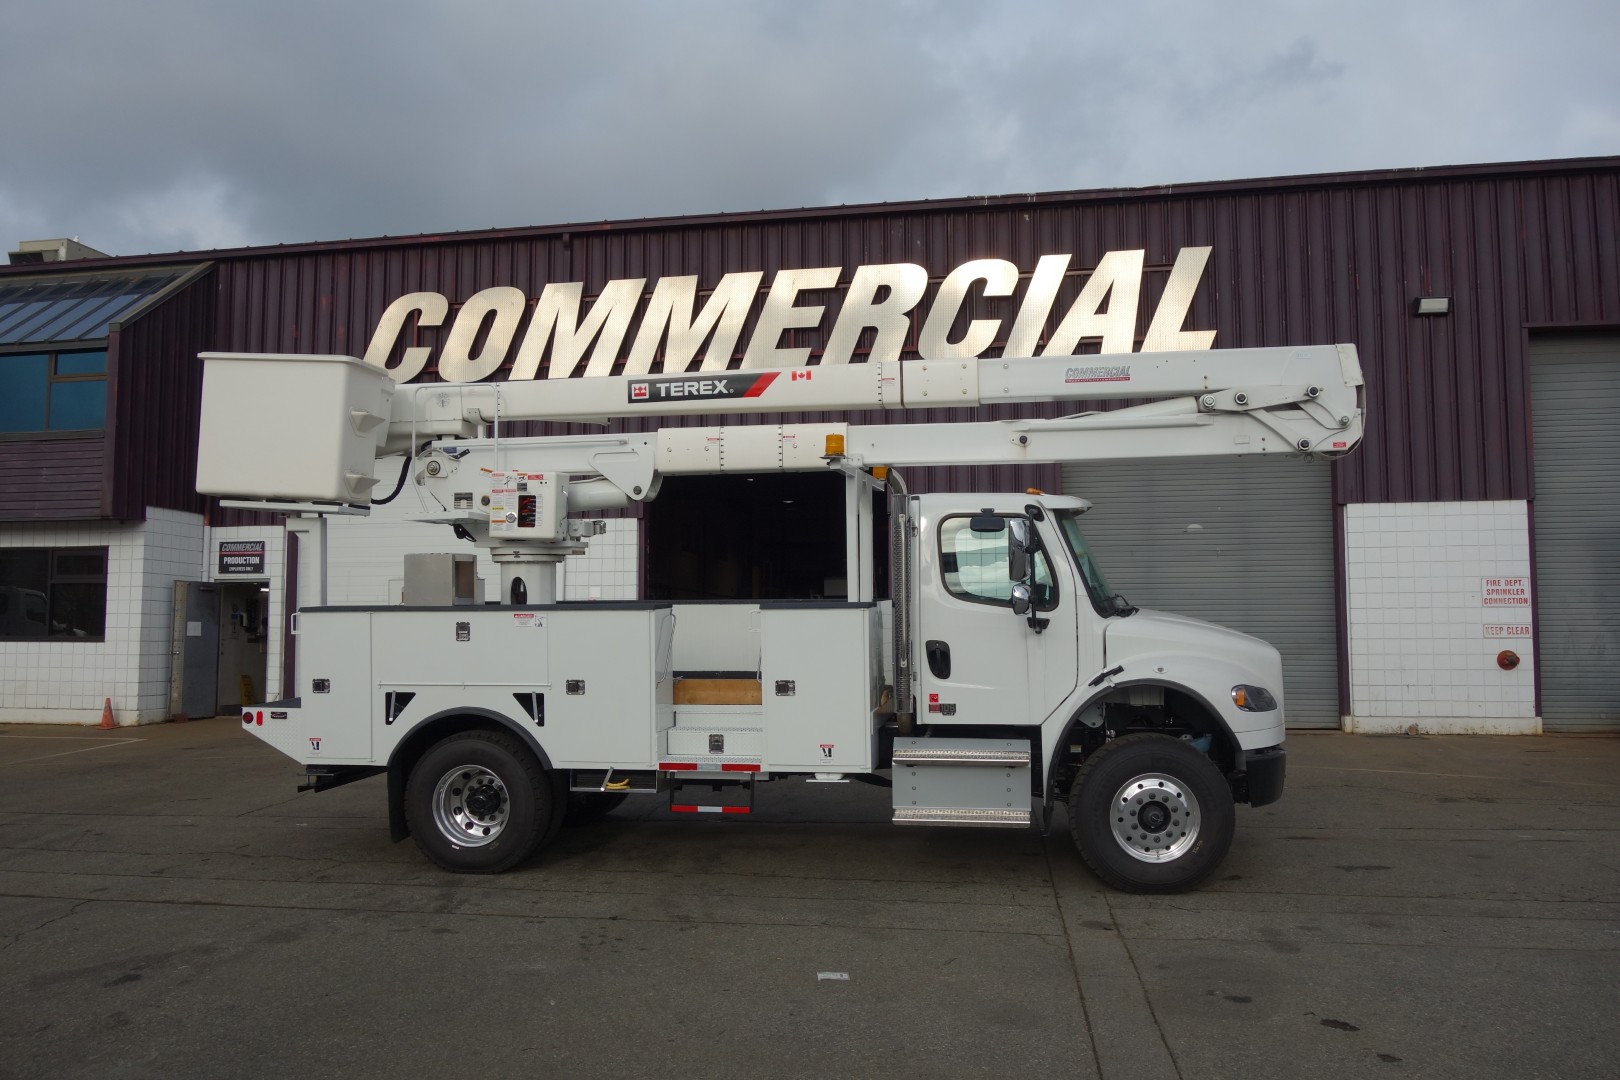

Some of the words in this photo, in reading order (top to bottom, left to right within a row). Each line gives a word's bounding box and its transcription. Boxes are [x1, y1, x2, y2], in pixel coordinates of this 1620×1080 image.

[362, 245, 1217, 384] COMMERCIAL
[1066, 366, 1131, 378] COMMERCIAL
[221, 542, 263, 551] COMMERCIAL
[223, 556, 260, 565] PRODUCTION
[1486, 579, 1502, 587] FIRE
[1504, 579, 1525, 587] DEPT.
[1486, 588, 1525, 596] SPRINKLER
[1483, 597, 1528, 605] CONNECTION
[1485, 626, 1504, 636] KEEP
[1506, 626, 1530, 636] CLEAR
